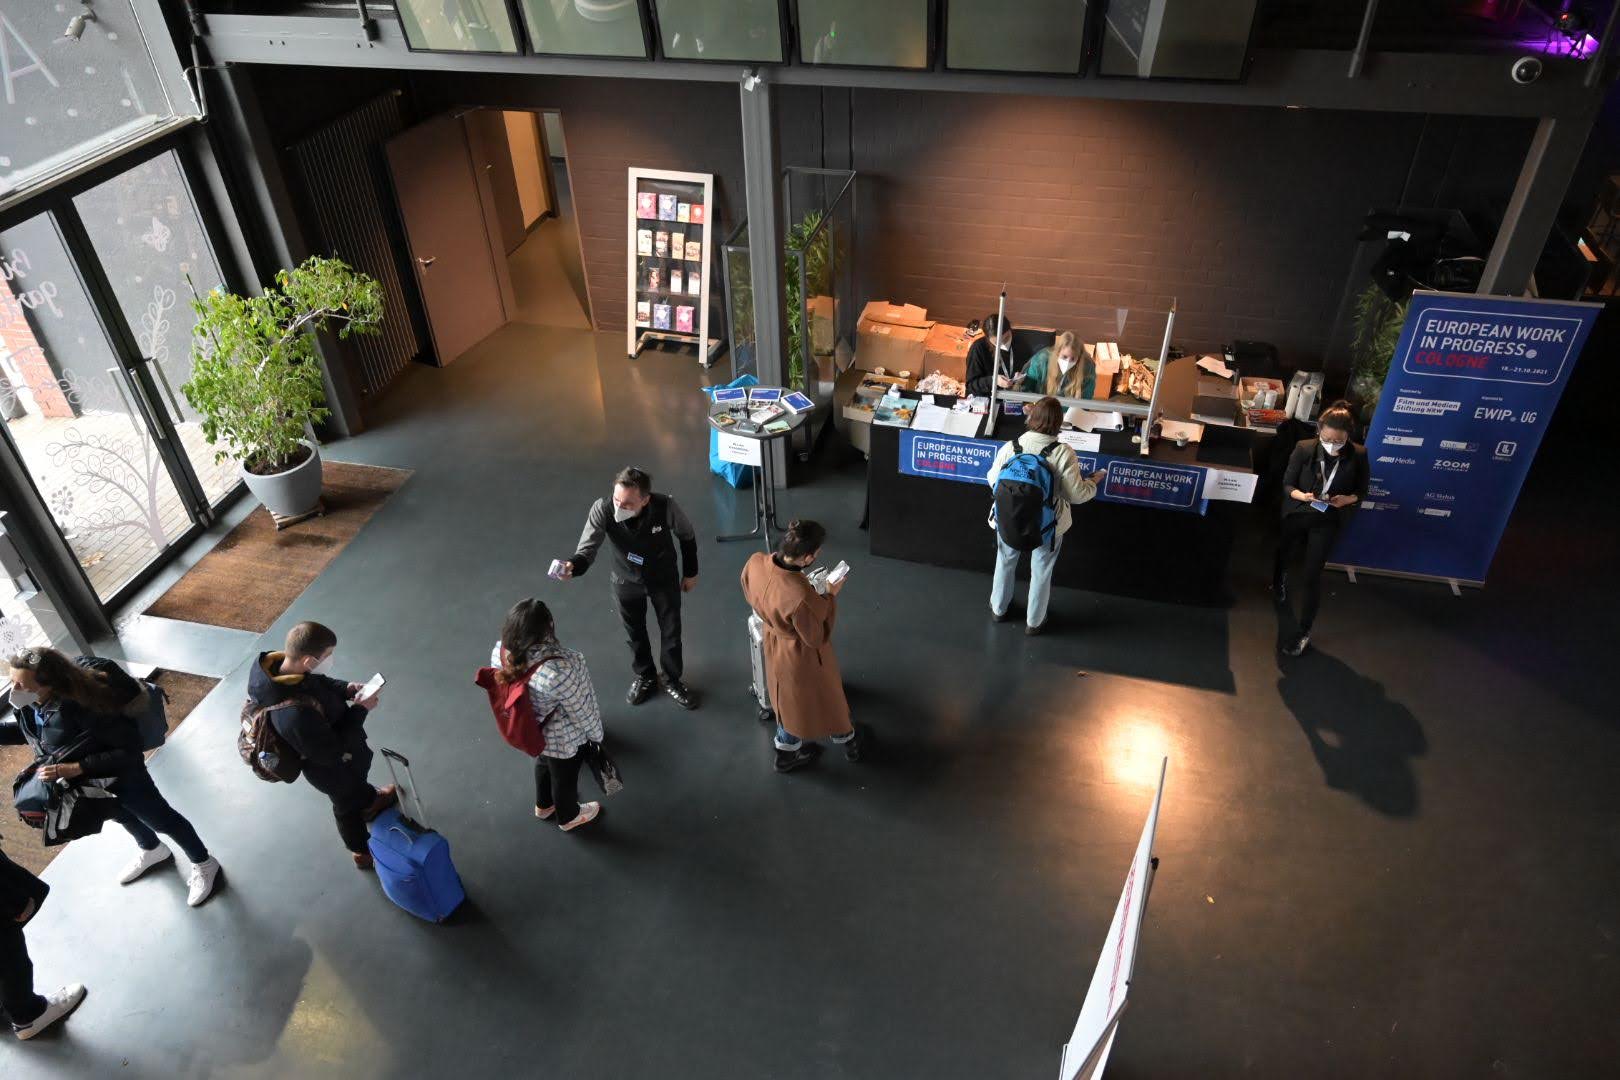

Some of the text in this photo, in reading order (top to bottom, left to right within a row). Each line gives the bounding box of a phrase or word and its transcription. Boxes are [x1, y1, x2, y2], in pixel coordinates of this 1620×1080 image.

[1425, 319, 1567, 343] EUROPEAN WORK
[1420, 336, 1438, 349] IN
[1415, 352, 1489, 369] COLOGNE
[1395, 405, 1425, 413] Stiftung
[1430, 401, 1459, 409] Medien
[1520, 411, 1537, 423] UG
[917, 441, 991, 458] EUROPEAN WORK
[917, 450, 926, 459] IN
[1395, 457, 1416, 465] Media
[1434, 459, 1471, 468] ZOOM
[1111, 475, 1120, 484] IN
[1113, 466, 1193, 484] EUROPEAN WORK
